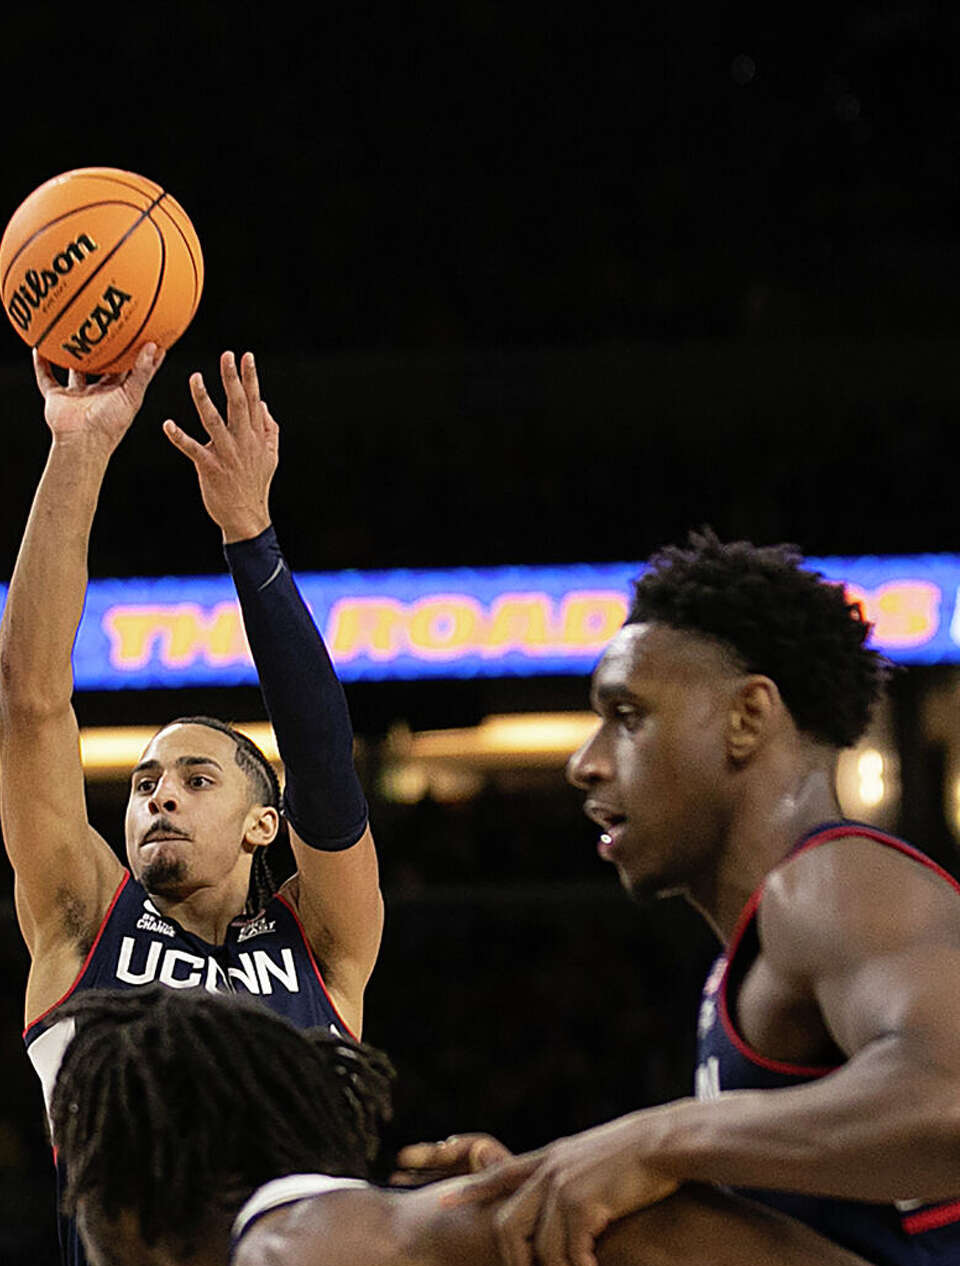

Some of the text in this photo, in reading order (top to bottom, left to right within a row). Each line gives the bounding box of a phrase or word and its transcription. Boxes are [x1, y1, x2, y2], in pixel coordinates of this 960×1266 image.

[8, 233, 98, 331] Wilson
[62, 285, 132, 361] NCAA
[103, 591, 634, 669] TH ROAD
